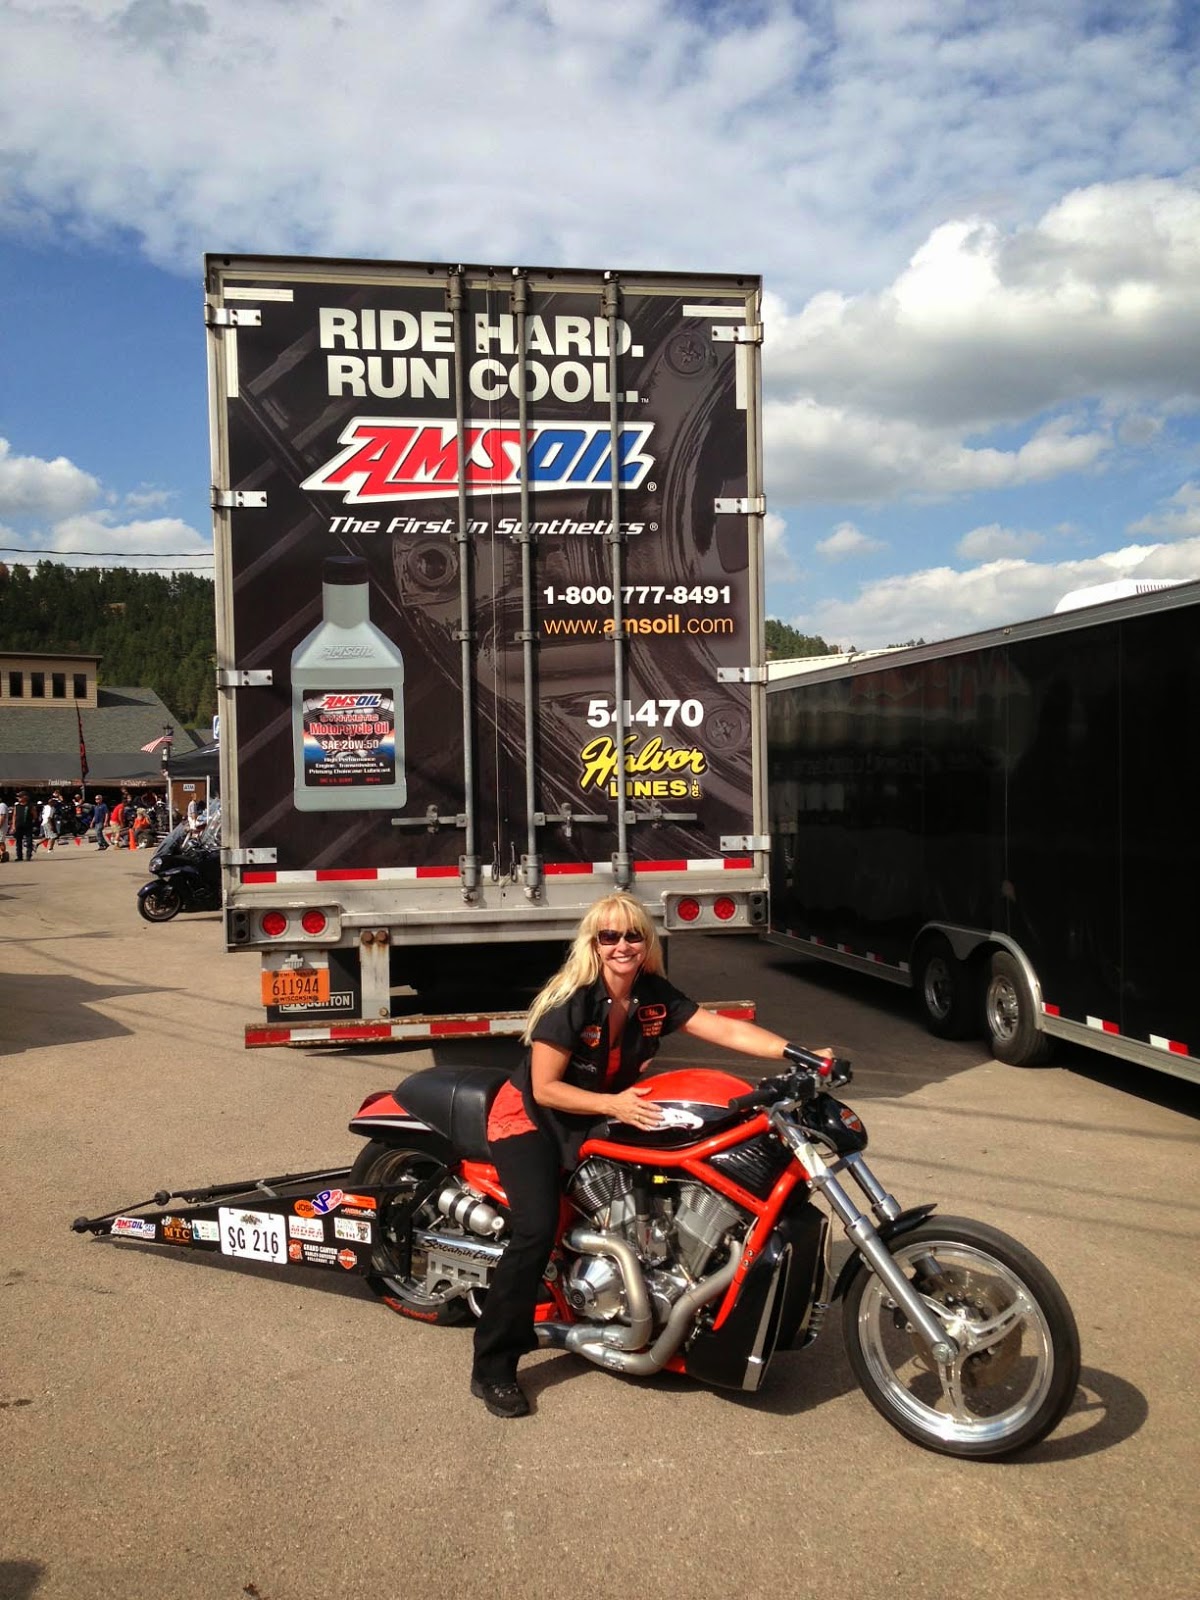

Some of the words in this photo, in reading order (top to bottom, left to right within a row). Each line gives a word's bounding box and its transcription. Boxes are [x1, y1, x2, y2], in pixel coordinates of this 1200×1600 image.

[319, 307, 455, 352] RIDE
[475, 312, 644, 357] HARD.
[327, 355, 450, 399] RUN
[469, 358, 639, 403] COOL.
[312, 420, 650, 501] AMSOIL
[328, 516, 380, 534] The
[386, 517, 456, 535] First
[466, 518, 488, 534] in
[543, 585, 731, 604] 1-800777-8491
[543, 614, 734, 634] www.amsoil.com
[320, 694, 380, 709] AMSOIL
[587, 699, 704, 728] 54470
[310, 723, 373, 736] Motorcycle
[374, 722, 389, 735] Oil
[321, 740, 339, 750] SAE
[580, 735, 706, 789] Halvor
[610, 779, 688, 797] LINES
[272, 978, 319, 996] 611944
[283, 995, 350, 1008] UGHTON
[114, 1219, 143, 1229] AMSOIL
[164, 1226, 190, 1239] MTC
[228, 1226, 246, 1250] SG
[252, 1229, 279, 1255] 216
[472, 1250, 502, 1265] Eagl
